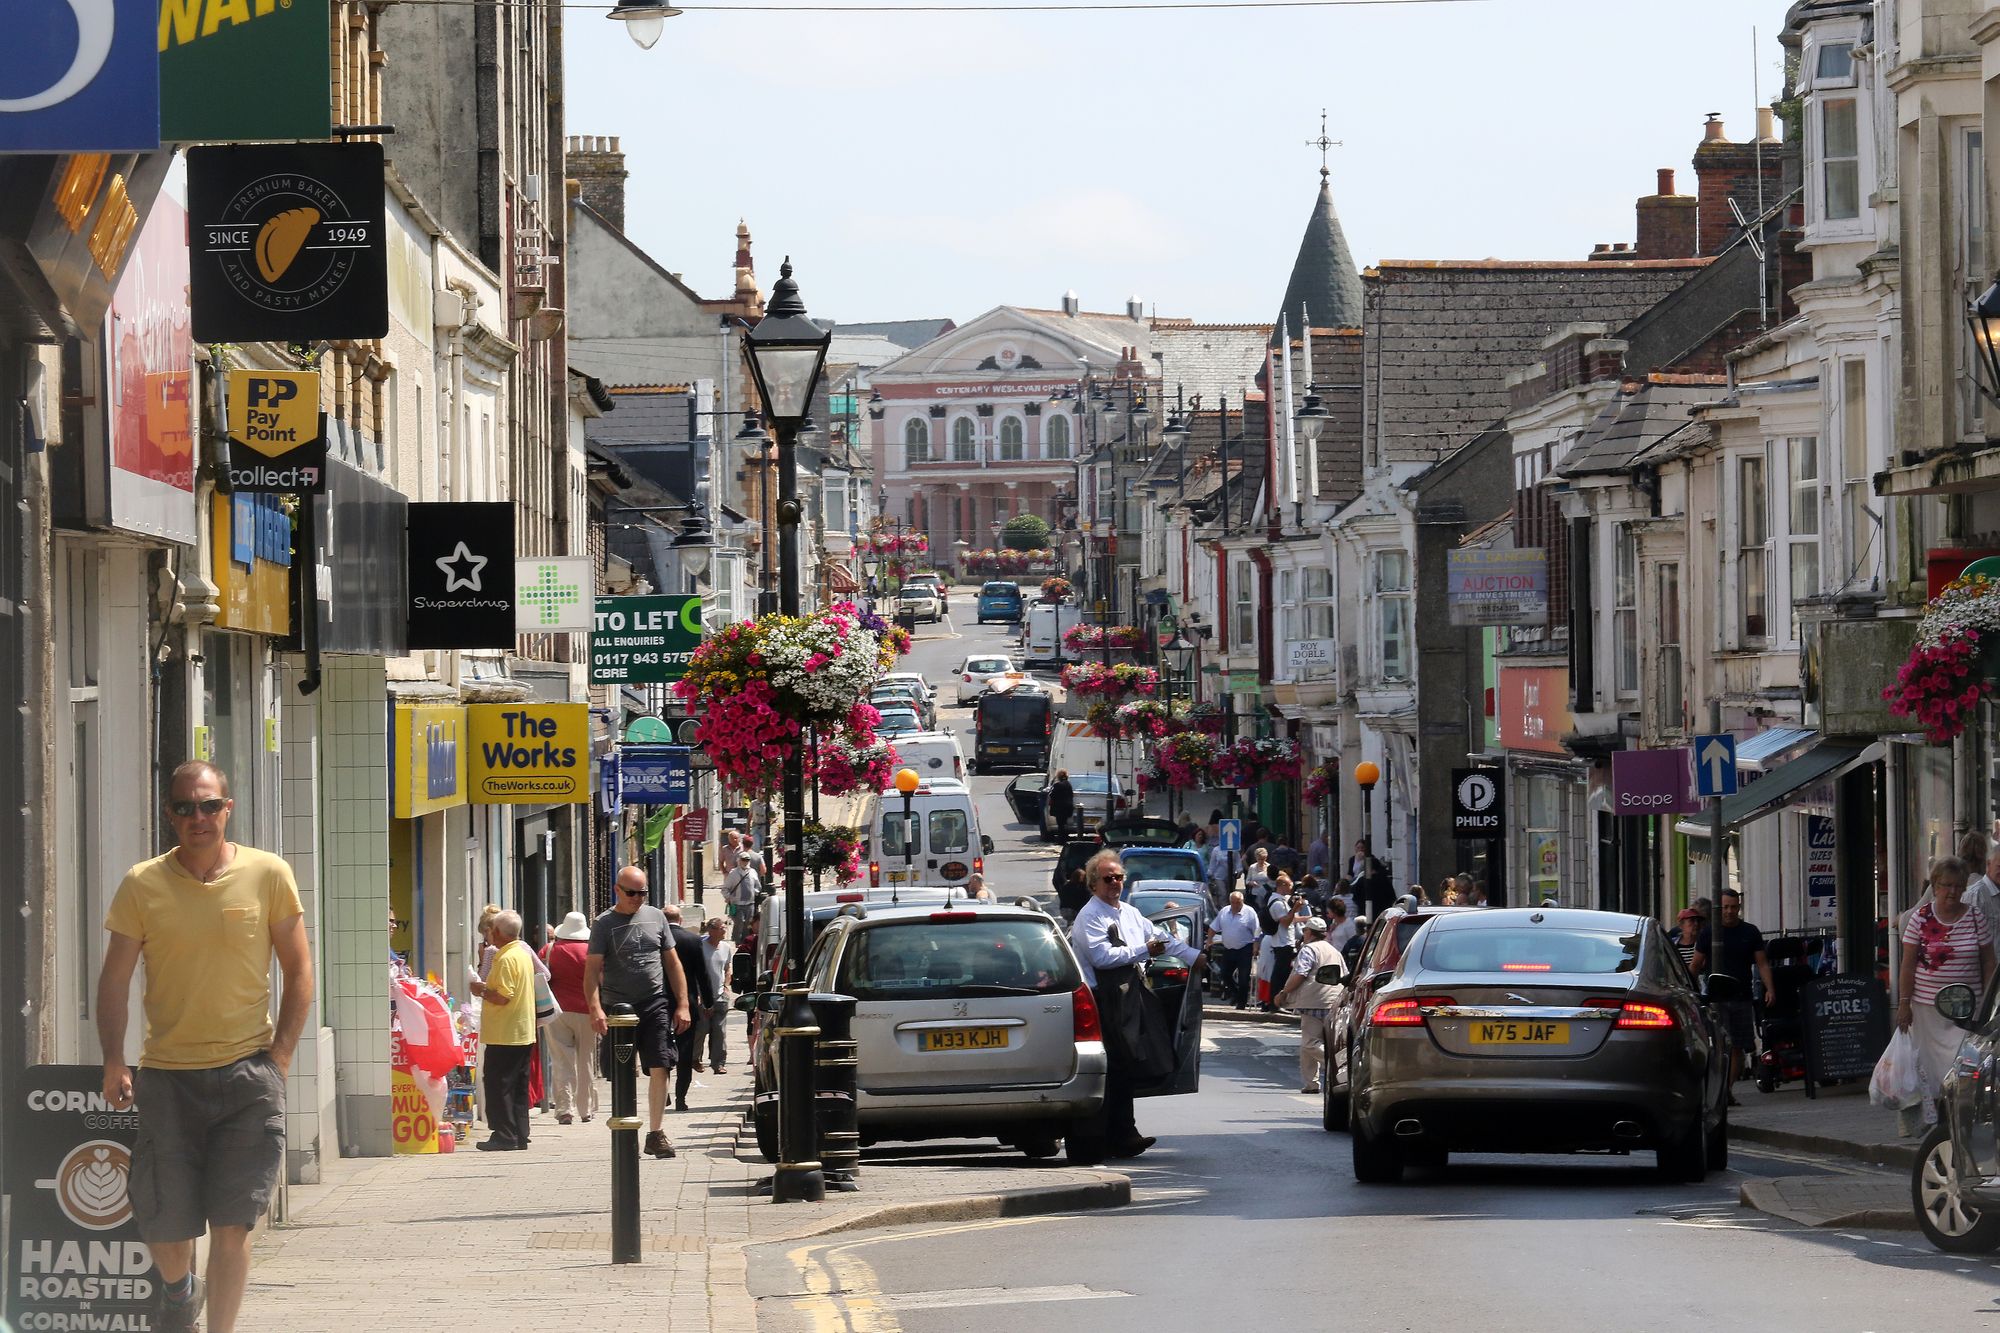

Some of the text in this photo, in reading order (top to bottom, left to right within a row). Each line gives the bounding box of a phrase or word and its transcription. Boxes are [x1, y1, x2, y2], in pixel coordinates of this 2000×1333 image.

[233, 179, 337, 212] PREMIUM BAKER
[208, 228, 367, 244] SINCE 1949
[227, 260, 347, 306] AND PASTY MAKER
[935, 386, 989, 394] CENTENARY
[992, 384, 1041, 393] WESLEYAN
[247, 409, 280, 428] Pay
[246, 426, 297, 442] Point
[1463, 576, 1535, 591] AUCTION
[1475, 591, 1537, 599] INVESTMENT
[414, 596, 510, 611] Superdrug
[595, 611, 678, 631] TO LET
[594, 636, 665, 647] ALL ENQUIRIES
[1300, 642, 1318, 651] ROY
[594, 651, 695, 665] 0117 943 5757
[1294, 650, 1326, 659] DOBLE
[594, 668, 628, 679] CBRE
[501, 710, 557, 738] The
[482, 740, 577, 769] Works
[487, 780, 571, 791] TheWorks.co.uk
[622, 775, 668, 784] HALIFAX
[1621, 792, 1673, 809] Scope
[1455, 815, 1498, 827] PHILPS
[1809, 850, 1833, 861] SIZES
[932, 1030, 1001, 1048] M33 KJH
[1482, 1024, 1556, 1041] N75 JAF
[392, 1096, 430, 1114] MUS
[20, 1239, 153, 1275] HAND
[19, 1276, 153, 1301] ROASTED
[80, 1301, 91, 1310] IN
[19, 1311, 152, 1333] CORNWALL
